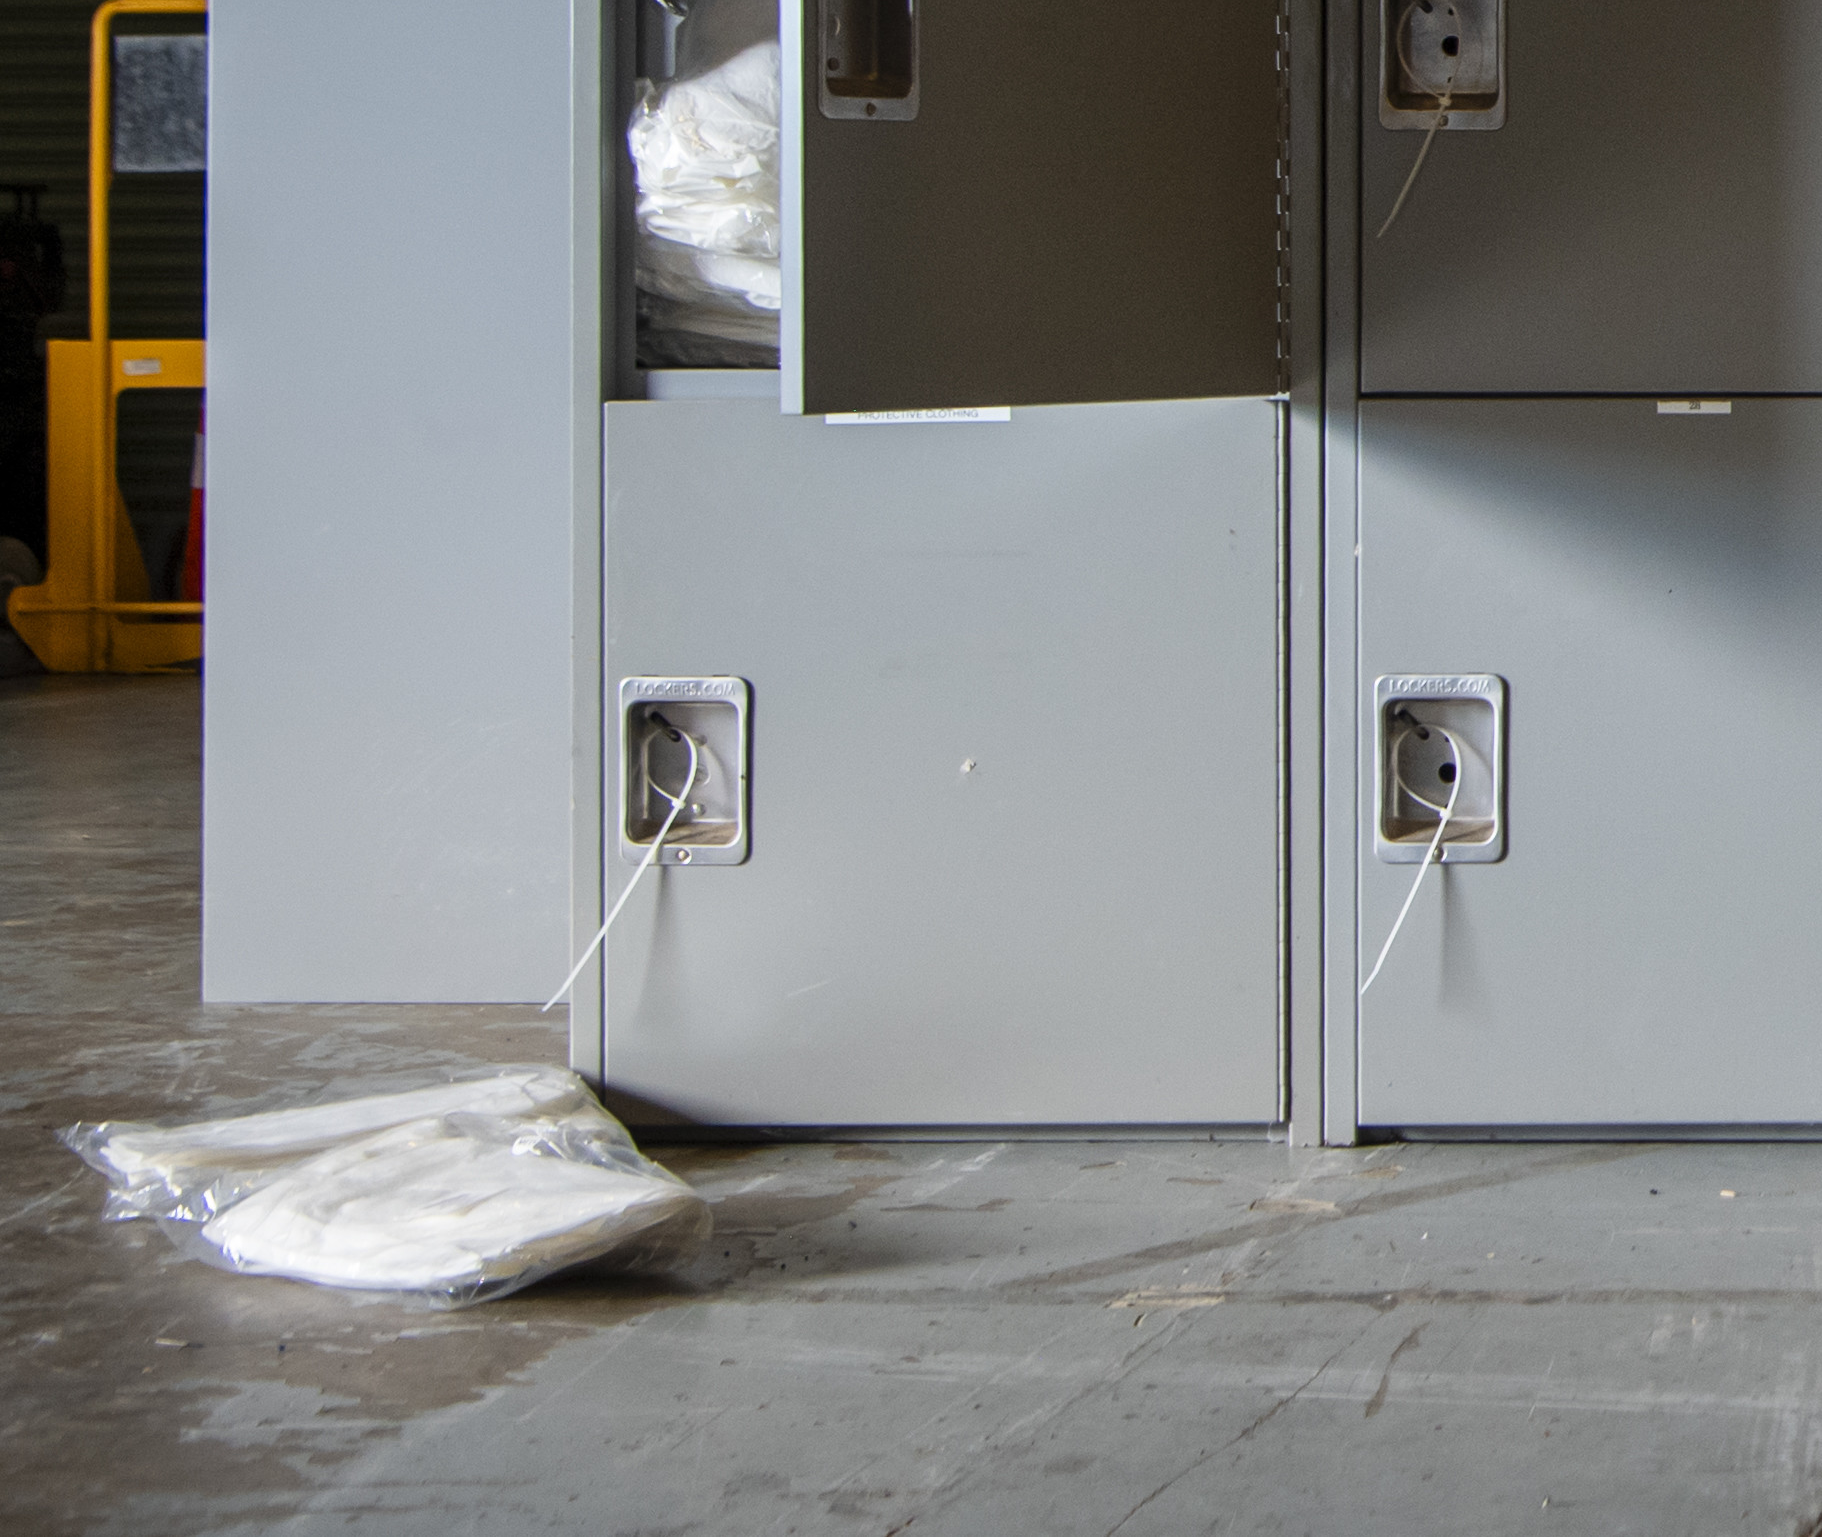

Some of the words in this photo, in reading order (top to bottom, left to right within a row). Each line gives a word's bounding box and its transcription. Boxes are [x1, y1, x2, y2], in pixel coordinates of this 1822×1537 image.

[857, 411, 922, 420] PROTECTIVE
[925, 409, 979, 418] CLOTHING
[635, 682, 736, 696] LOCKERS.COM
[1388, 678, 1490, 693] LOCKERS.COM
